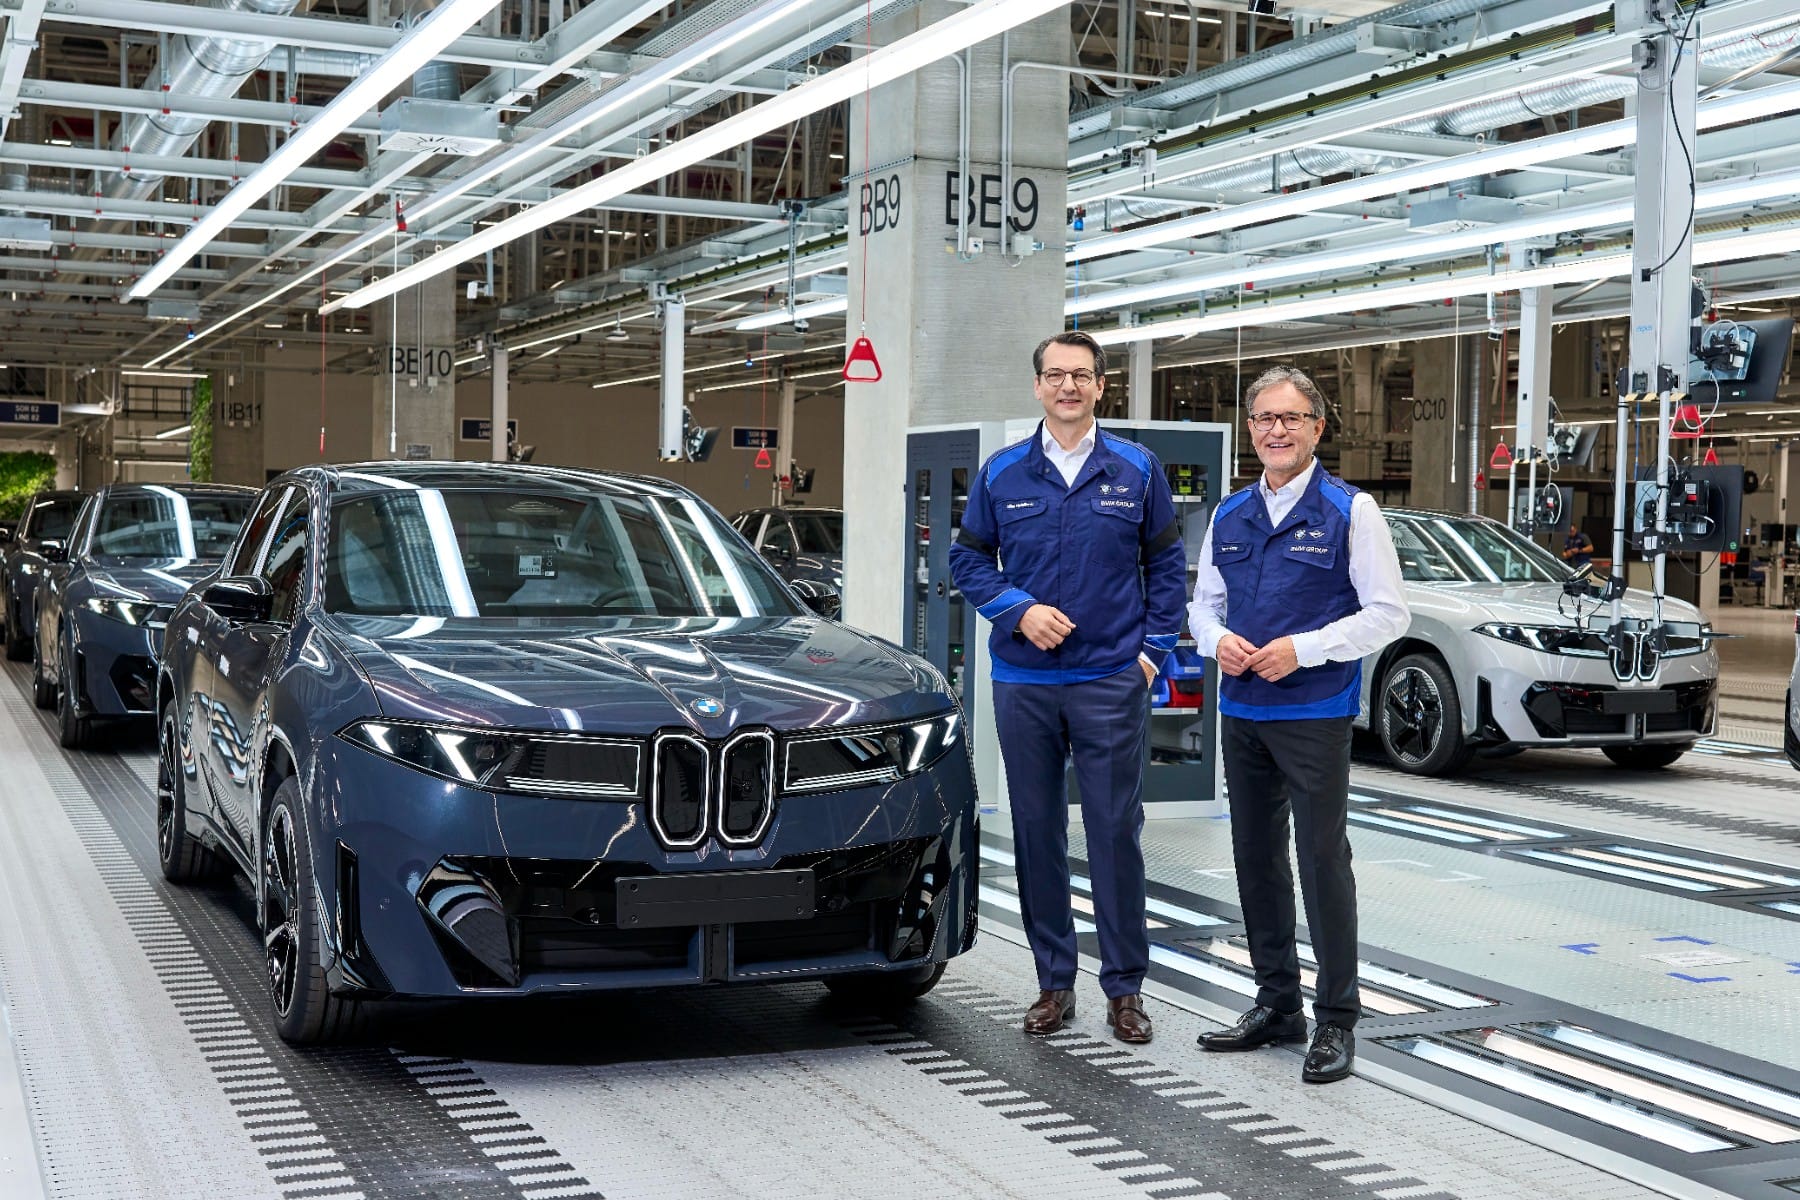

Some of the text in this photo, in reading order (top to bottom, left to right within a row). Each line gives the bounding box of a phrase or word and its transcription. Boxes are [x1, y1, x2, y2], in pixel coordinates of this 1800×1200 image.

[860, 173, 900, 236] BB9
[14, 413, 29, 421] LINE
[221, 401, 262, 421] BB11
[1412, 398, 1446, 421] CC10
